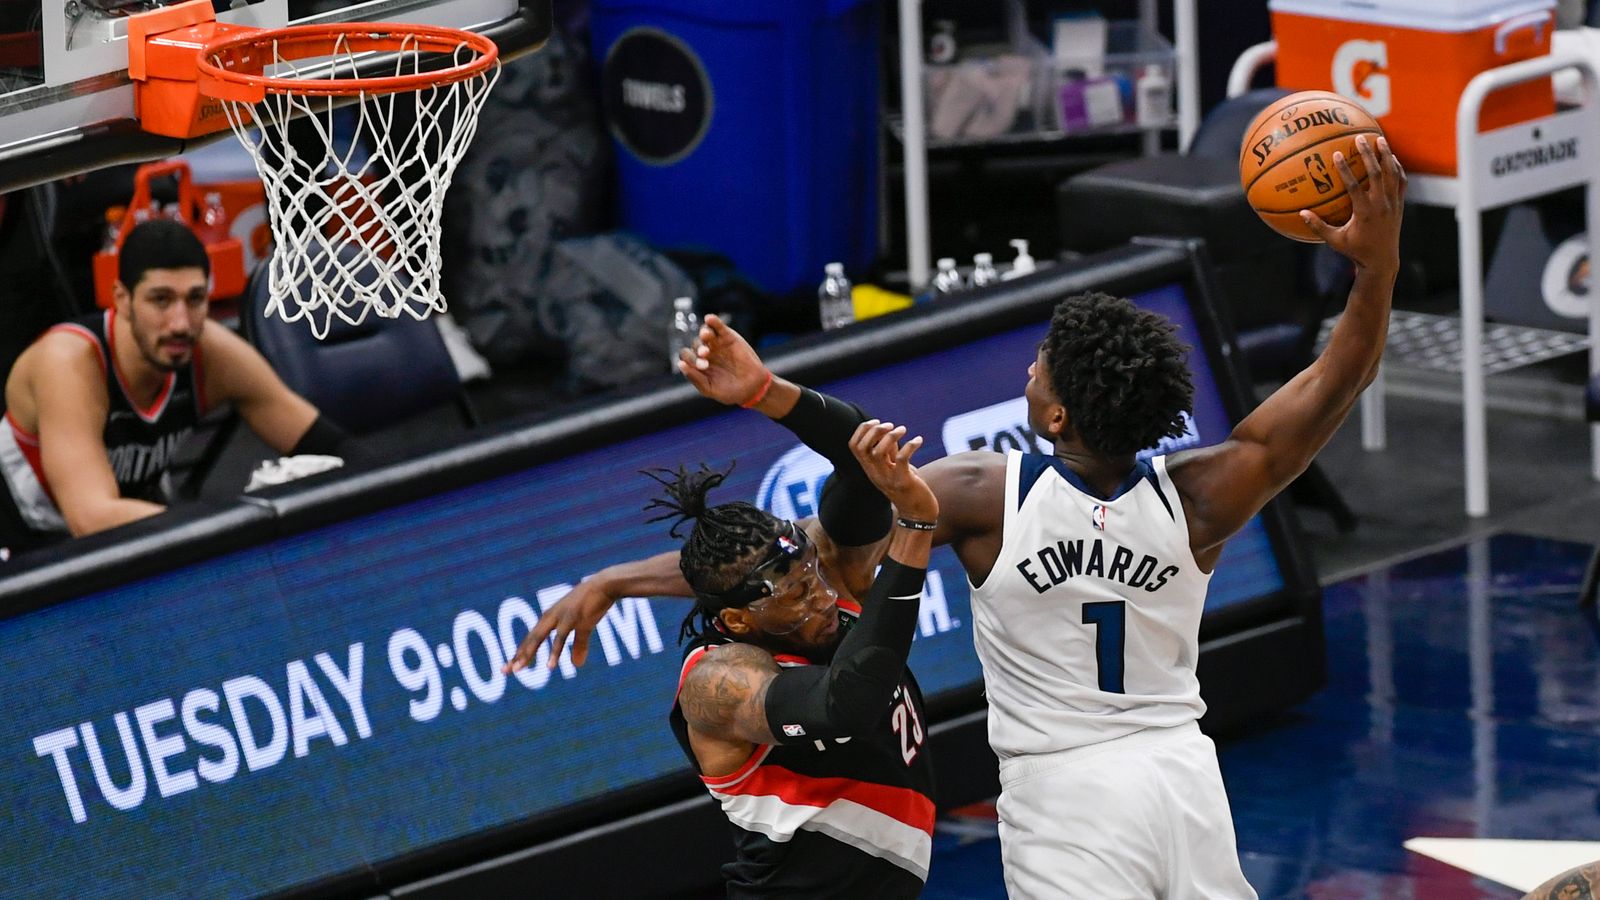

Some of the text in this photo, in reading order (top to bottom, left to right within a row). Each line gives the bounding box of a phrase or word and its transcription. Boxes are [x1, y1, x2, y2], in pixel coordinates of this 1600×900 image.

[1331, 39, 1391, 118] G
[1252, 107, 1349, 166] SPALDING
[1017, 539, 1179, 594] EDWARDS
[1082, 600, 1125, 694] 1
[33, 642, 372, 824] TUESDAY
[892, 686, 923, 767] 23
